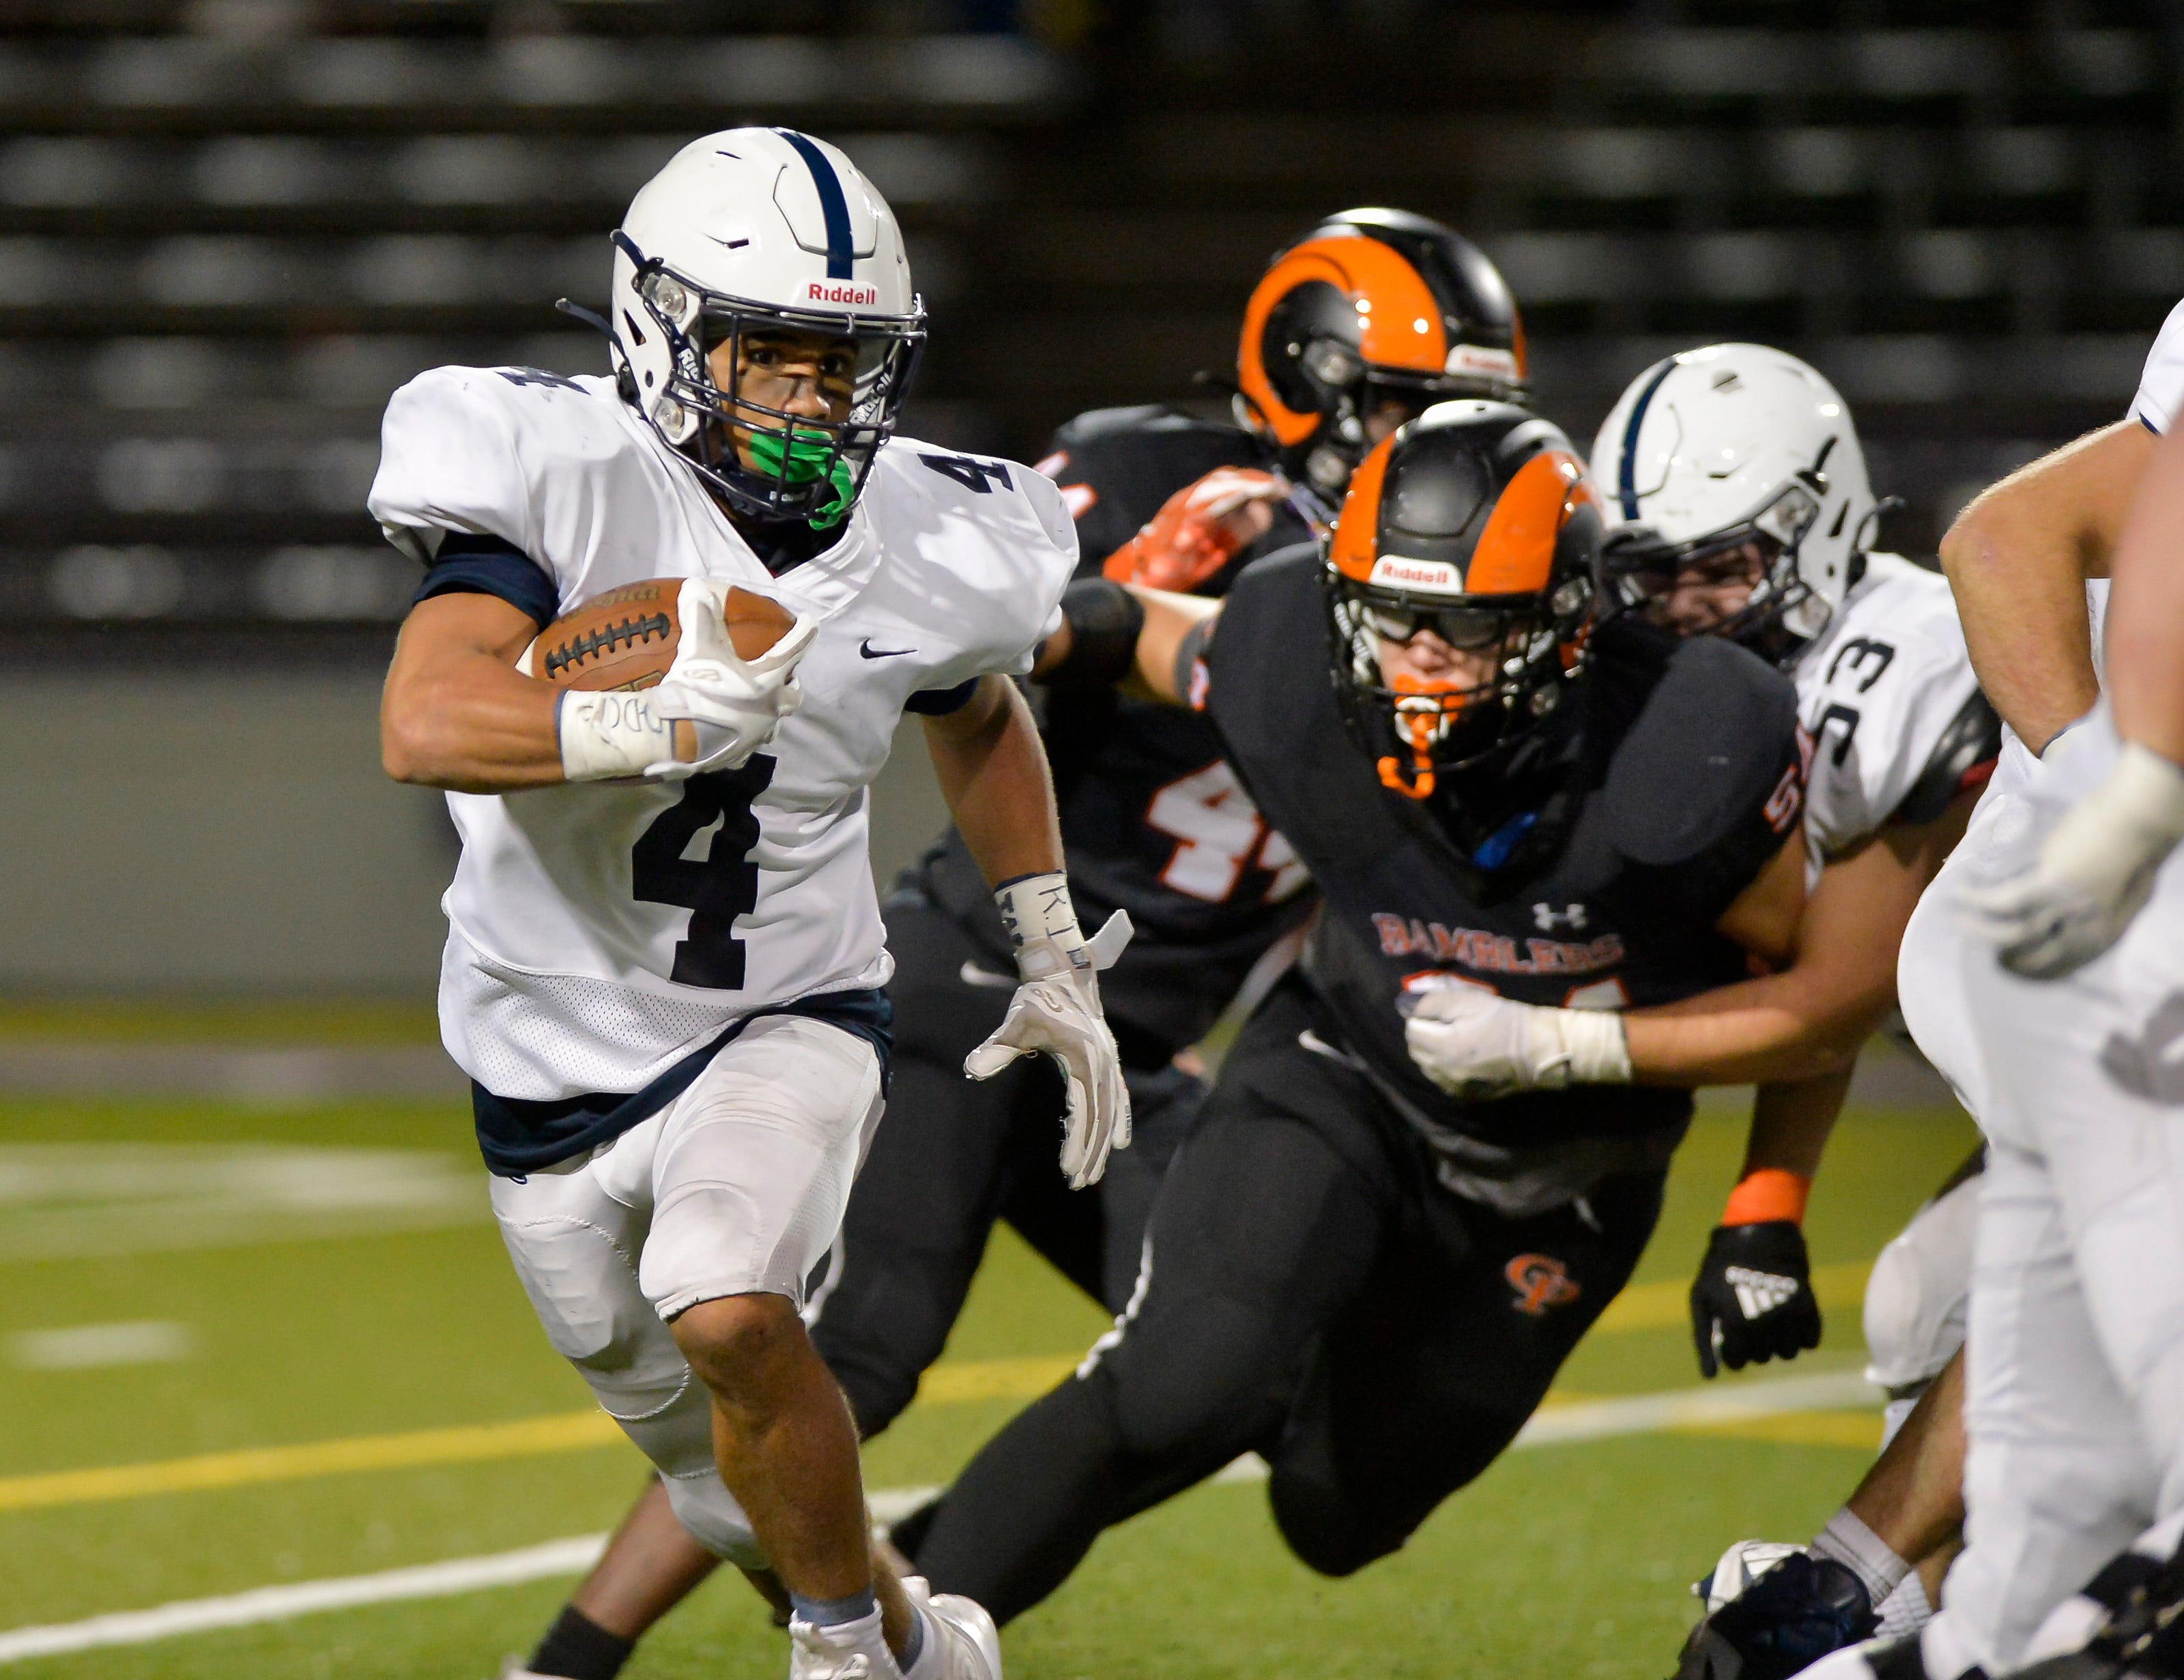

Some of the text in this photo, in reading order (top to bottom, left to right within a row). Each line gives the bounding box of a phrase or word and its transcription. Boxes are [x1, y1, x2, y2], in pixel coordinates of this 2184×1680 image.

[808, 283, 876, 305] Riddell
[917, 452, 1014, 493] 4
[1383, 562, 1448, 583] Riddell
[632, 751, 777, 991] 4
